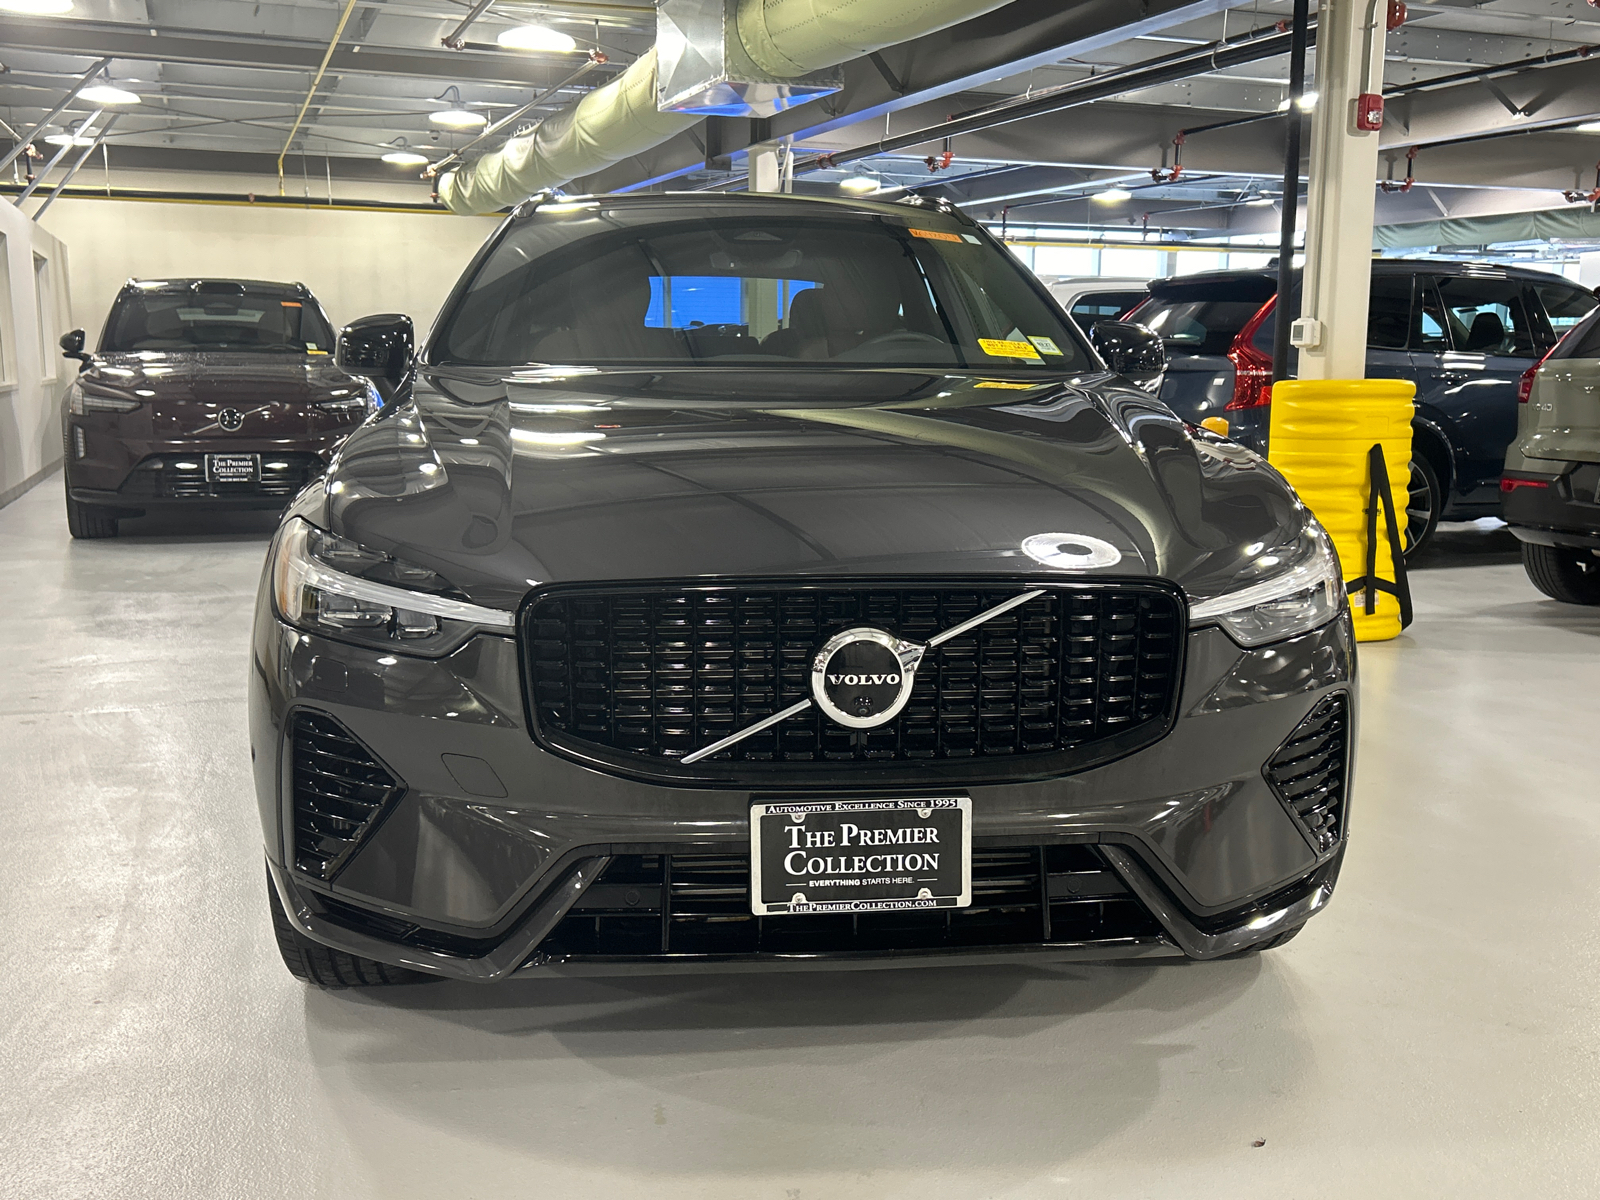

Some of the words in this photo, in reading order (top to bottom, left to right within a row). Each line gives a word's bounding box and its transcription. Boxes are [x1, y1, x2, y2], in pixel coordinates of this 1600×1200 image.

[213, 459, 226, 467] THE
[227, 459, 253, 467] PREMIER
[827, 673, 900, 685] VOLVO
[768, 804, 832, 814] AUTOMOTIVE
[834, 801, 896, 811] EXCELLENCE
[897, 800, 927, 809] SINCE
[929, 799, 957, 808] 1995
[784, 825, 836, 849] THE
[839, 823, 940, 847] PREMIER
[784, 850, 940, 876] COLLECTION
[809, 878, 861, 887] EVERYTHING
[862, 877, 891, 886] STARTS
